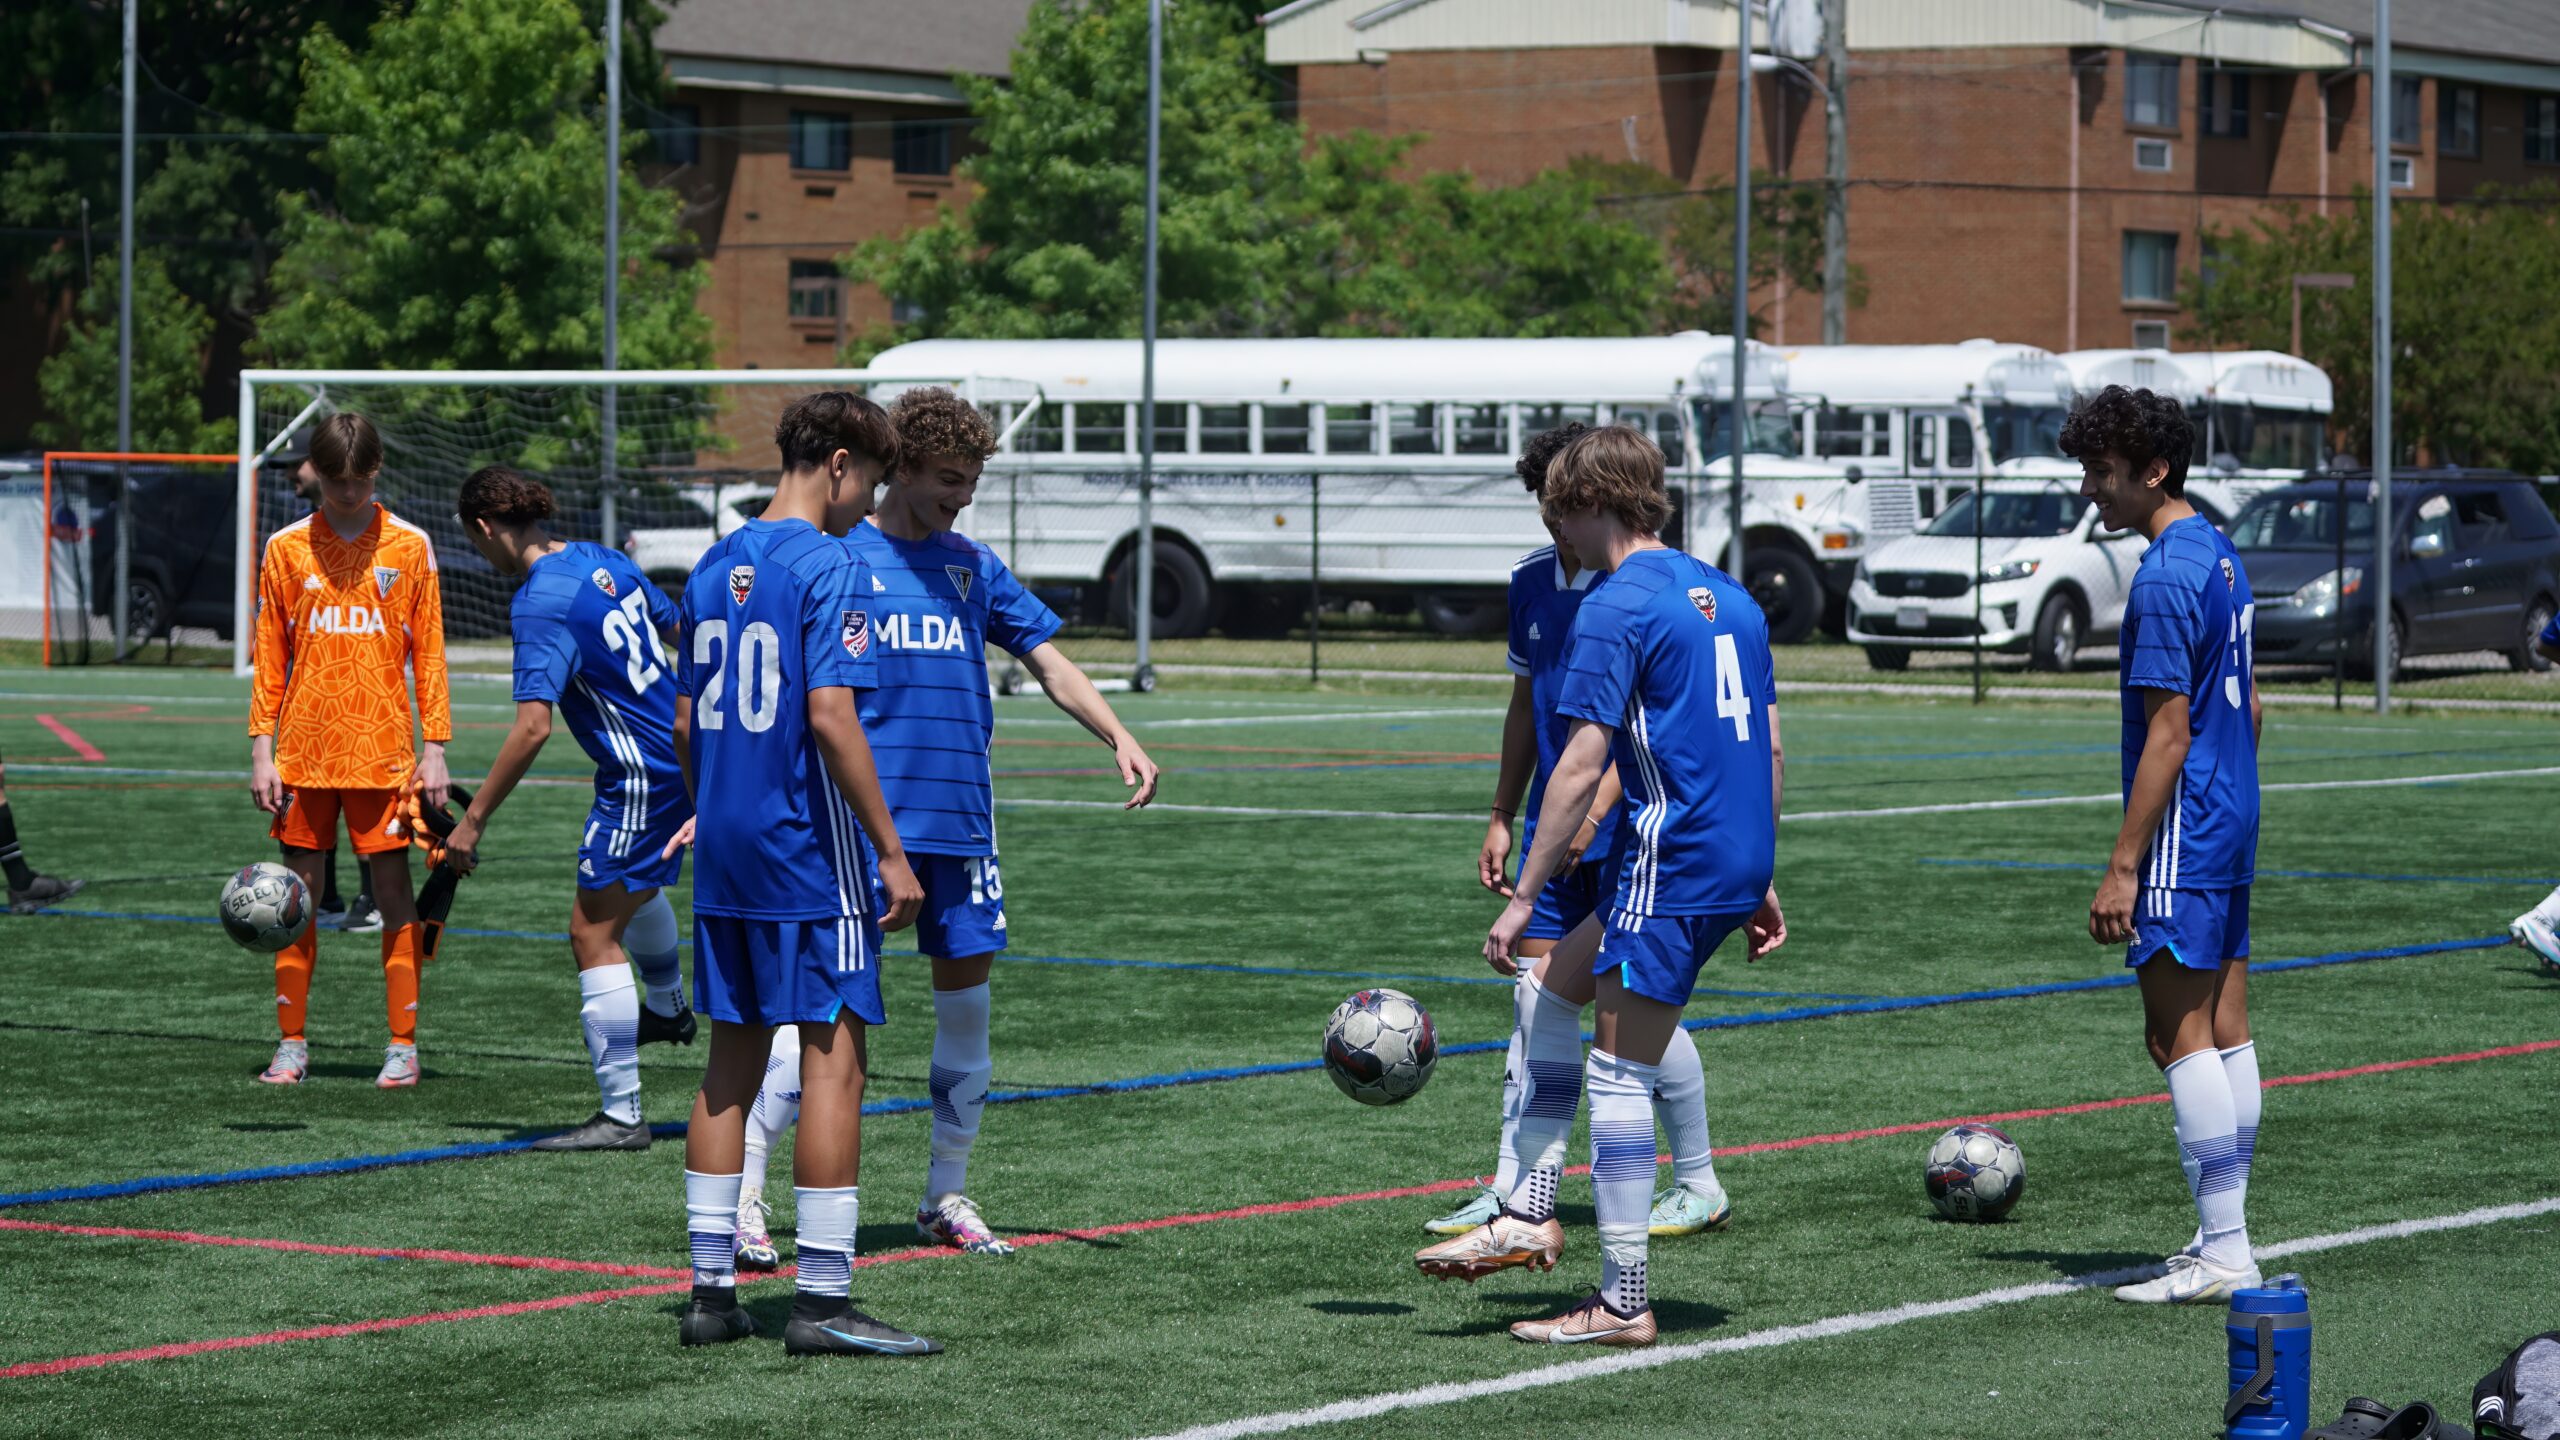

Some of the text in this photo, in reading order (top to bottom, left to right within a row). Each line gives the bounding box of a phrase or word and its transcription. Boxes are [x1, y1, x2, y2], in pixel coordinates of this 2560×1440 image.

[309, 605, 386, 636] MLDA
[602, 585, 667, 696] 27
[874, 614, 966, 652] MLDA
[693, 619, 781, 733] 20
[1714, 633, 1751, 742] 4
[231, 882, 280, 913] SELECT
[963, 855, 1003, 904] 15
